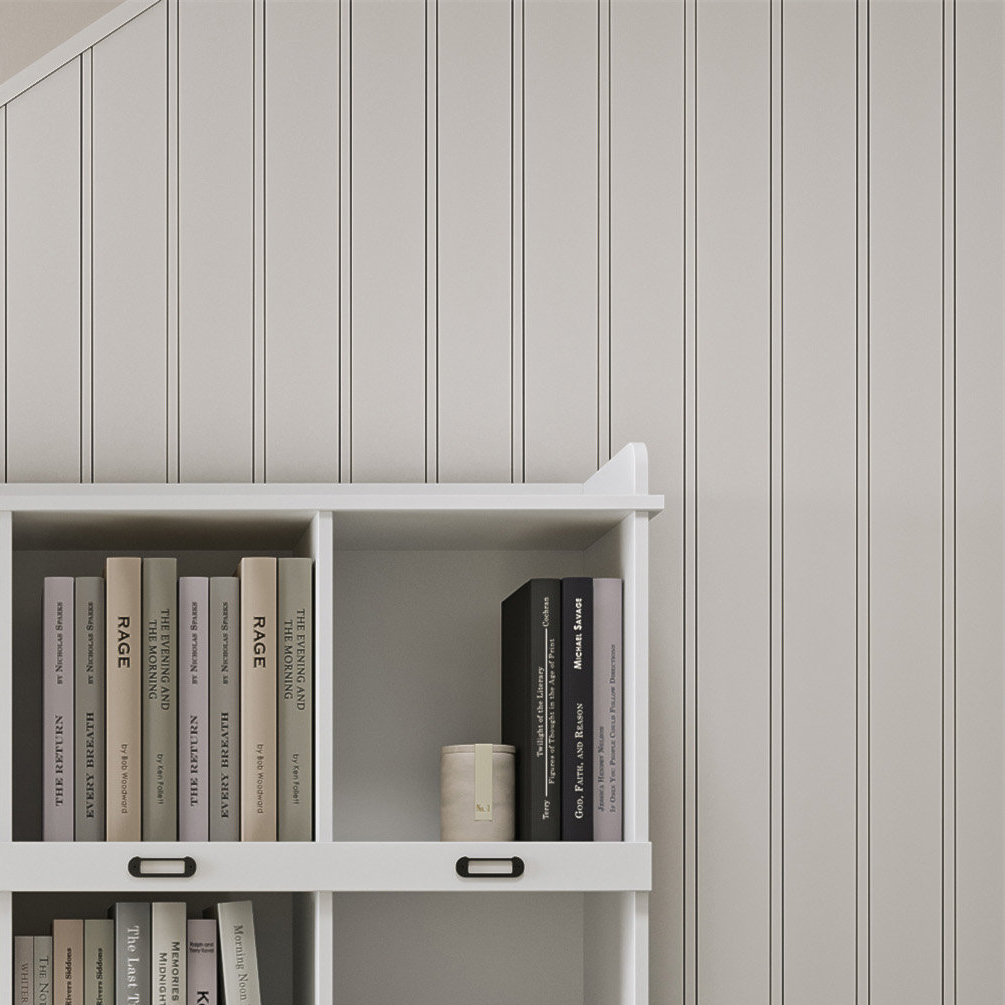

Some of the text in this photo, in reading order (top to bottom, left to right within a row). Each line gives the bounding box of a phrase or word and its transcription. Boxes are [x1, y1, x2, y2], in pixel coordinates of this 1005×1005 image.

[118, 616, 130, 668] RAGE
[149, 619, 158, 700] THE MORNING
[160, 609, 170, 710] THE EVENING AND
[254, 616, 265, 668] RAGE
[574, 598, 582, 669] MICHAEL SAVAGE
[537, 665, 545, 758] Twilight of the Literary
[55, 715, 63, 806] THE RETURN
[86, 712, 94, 818] EVERY BREATH
[120, 743, 128, 755] by
[120, 771, 128, 814] Woodward
[172, 942, 180, 1001] MEMORIES
